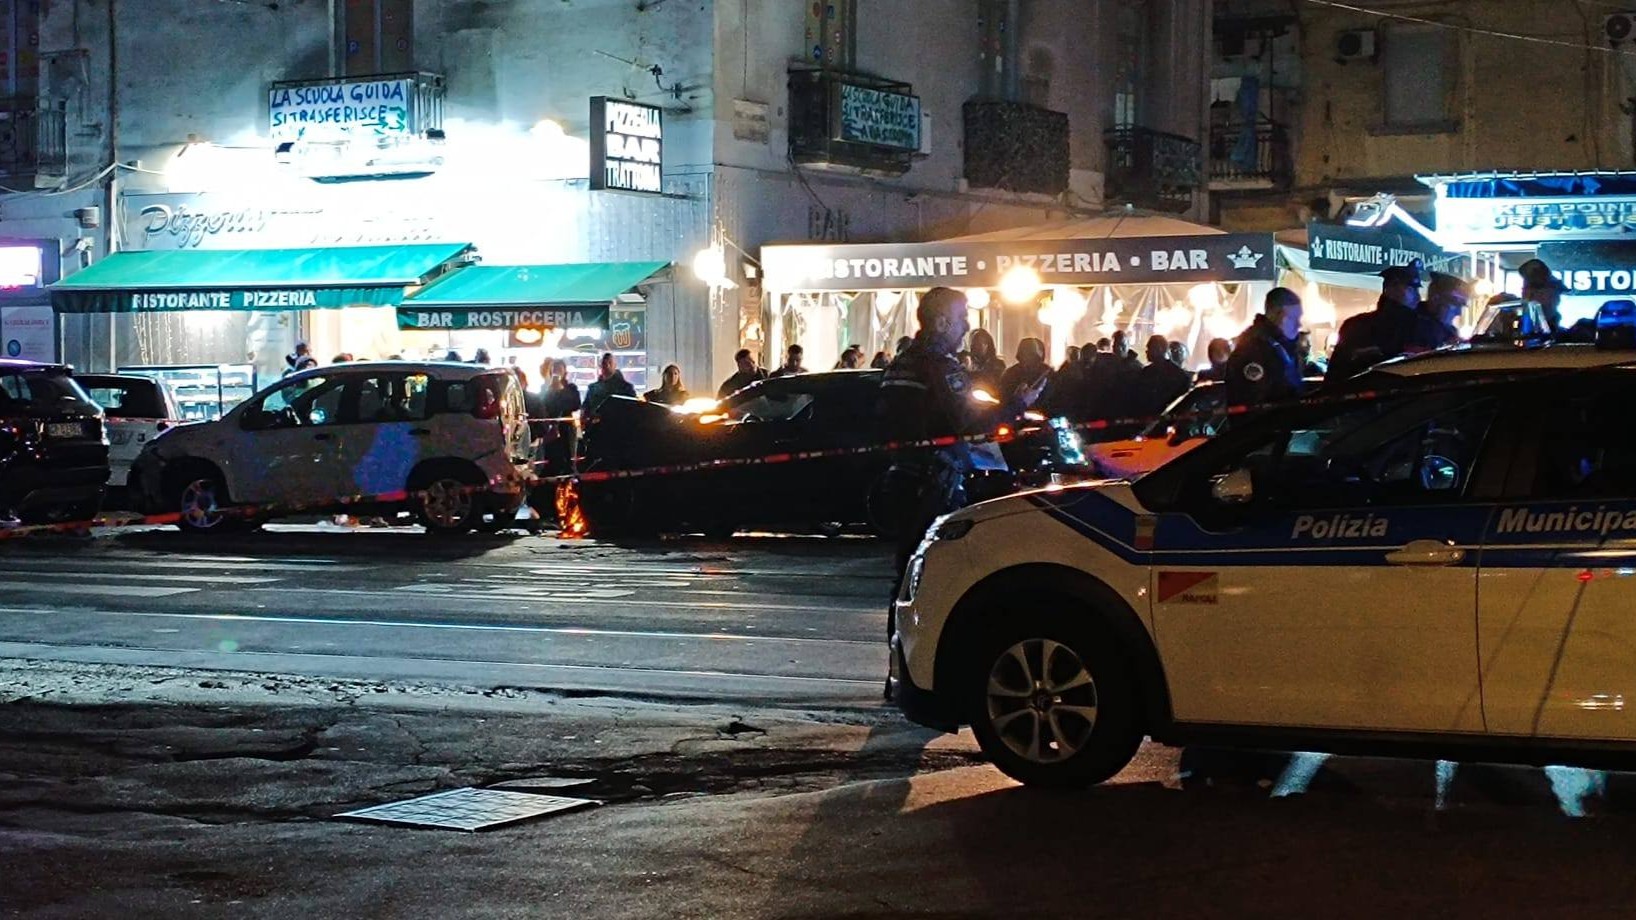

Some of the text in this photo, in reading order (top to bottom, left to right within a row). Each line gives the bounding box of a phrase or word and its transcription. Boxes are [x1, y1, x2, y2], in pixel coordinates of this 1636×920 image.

[271, 82, 404, 108] LA SCUOLA GUIDA
[605, 101, 662, 138] PIZZERIA
[605, 133, 662, 164] BAR
[808, 204, 851, 240] BAR
[815, 255, 968, 279] ISTORANTE
[1151, 249, 1209, 271] BAR
[1325, 239, 1383, 265] RISTORANTE
[1552, 270, 1636, 292] ISTO
[132, 290, 316, 309] RISTORANTE PIZZERIA
[417, 311, 584, 327] BAR ROSTICCERIA
[1290, 512, 1389, 539] Polizia
